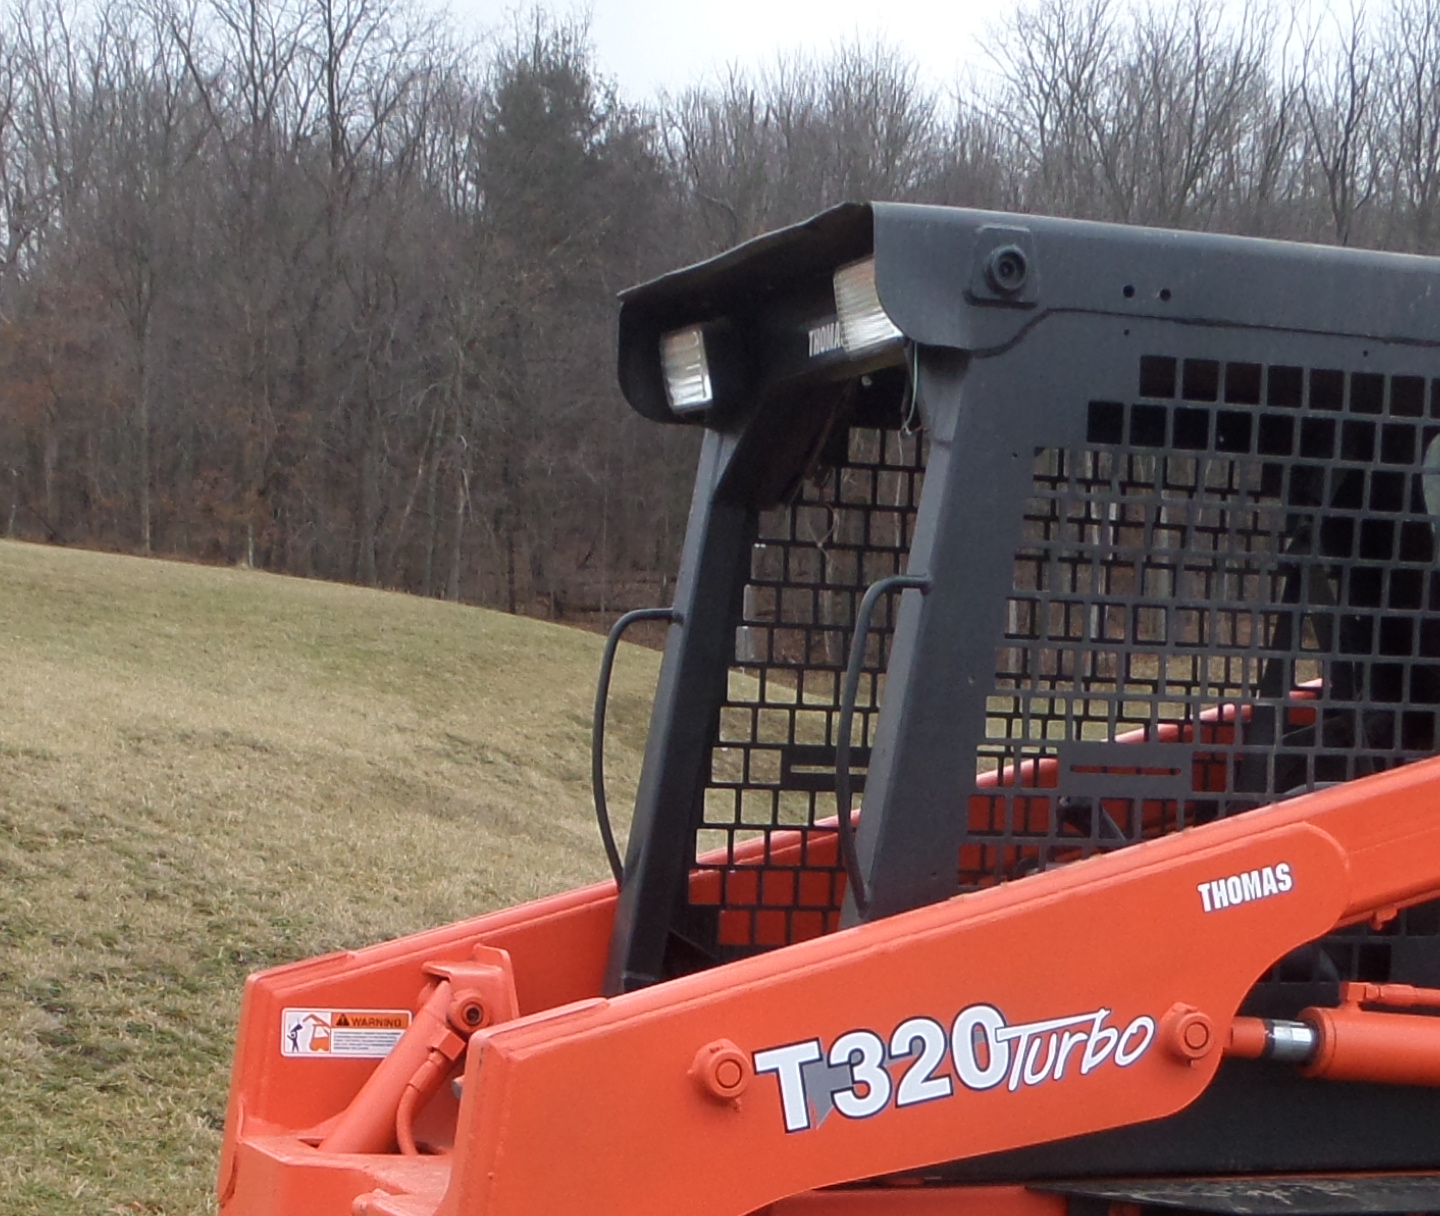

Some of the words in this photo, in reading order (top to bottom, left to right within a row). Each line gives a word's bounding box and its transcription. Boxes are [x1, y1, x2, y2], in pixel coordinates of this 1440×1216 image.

[808, 321, 841, 357] THOMA
[1197, 862, 1293, 912] THOMAS
[351, 1016, 402, 1028] WARNING
[753, 1003, 1009, 1133] T320
[996, 1008, 1156, 1092] Turbo
